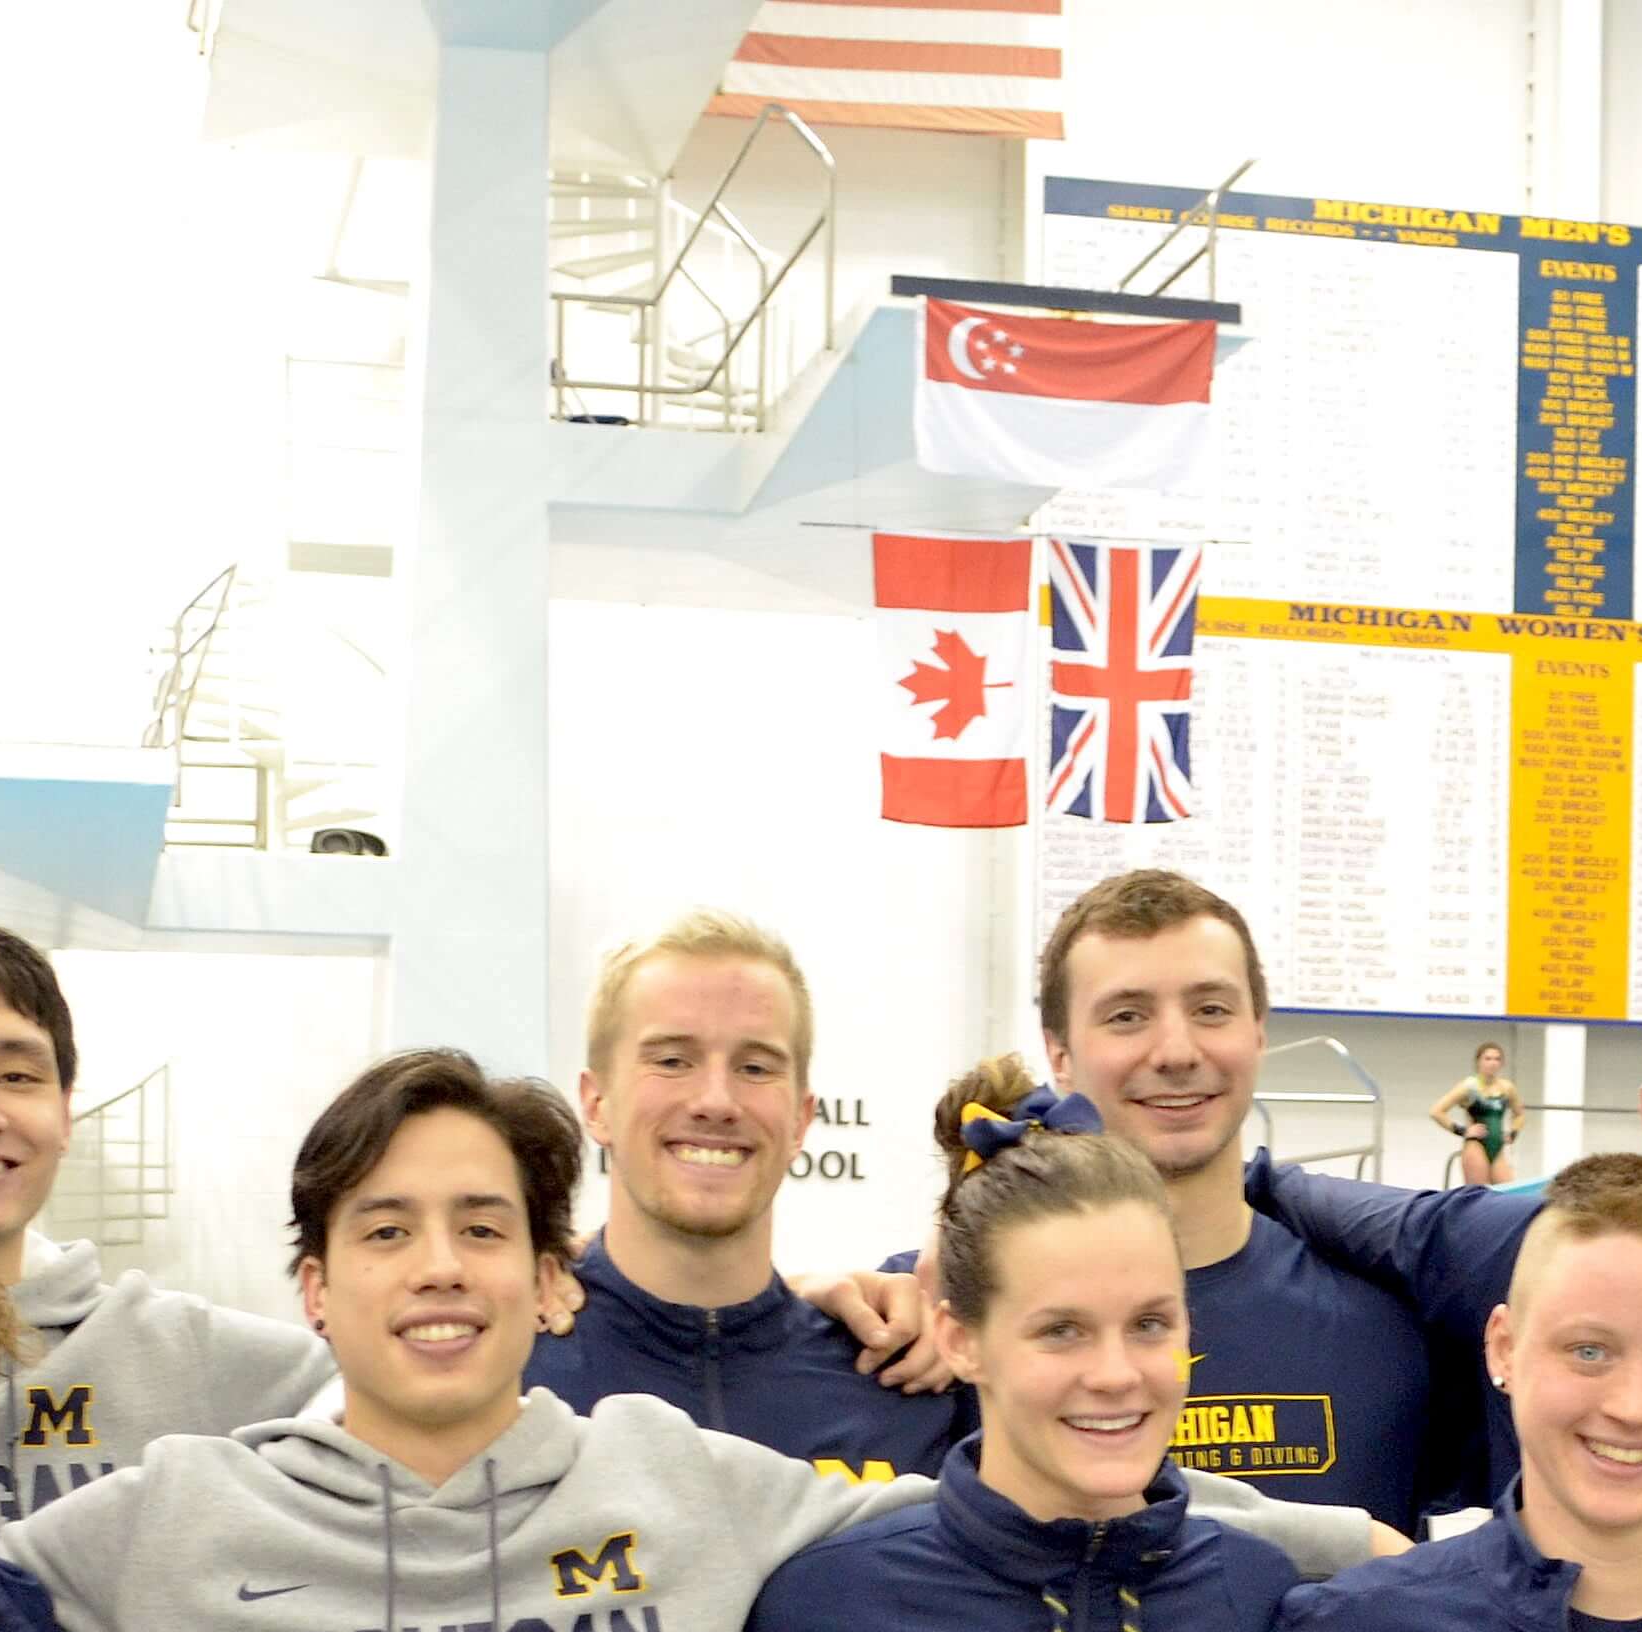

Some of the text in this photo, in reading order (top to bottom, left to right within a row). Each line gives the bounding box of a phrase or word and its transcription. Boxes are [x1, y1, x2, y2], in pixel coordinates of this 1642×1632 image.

[1266, 216, 1355, 238] RECORDS
[1312, 199, 1500, 235] MICHIGAN
[1519, 214, 1631, 246] MEN'S
[1539, 259, 1618, 283] EVENTS
[1289, 603, 1471, 632] MICHIGAN
[1536, 659, 1610, 678] EVENTS
[21, 1384, 101, 1447] M
[1168, 1404, 1276, 1447] HIGAN
[1251, 1446, 1320, 1466] DIVING
[551, 1530, 647, 1598] M
